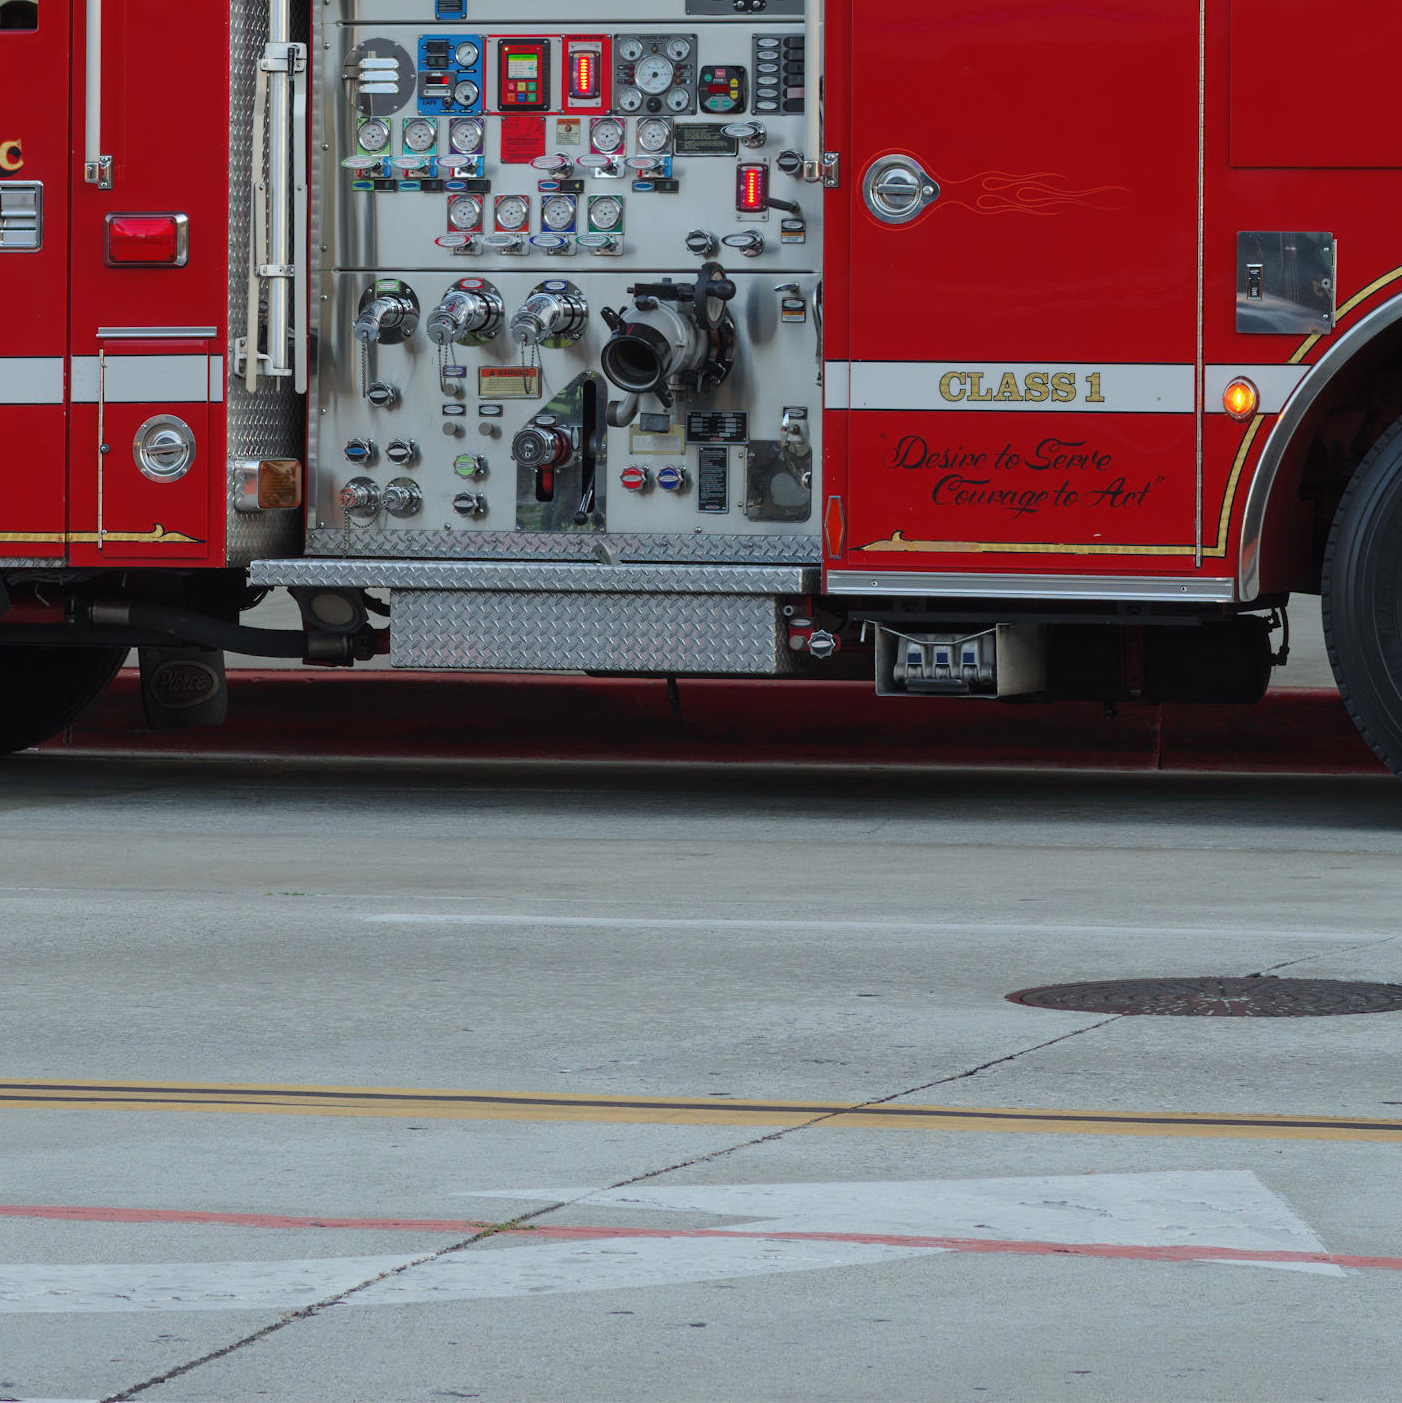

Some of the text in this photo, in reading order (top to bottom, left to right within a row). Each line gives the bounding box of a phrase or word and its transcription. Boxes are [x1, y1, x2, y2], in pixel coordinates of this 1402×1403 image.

[939, 372, 1105, 402] CLASS 1
[994, 442, 1021, 470] to
[1023, 438, 1112, 471] Serve
[932, 474, 1050, 521] Courage
[1052, 480, 1078, 508] to
